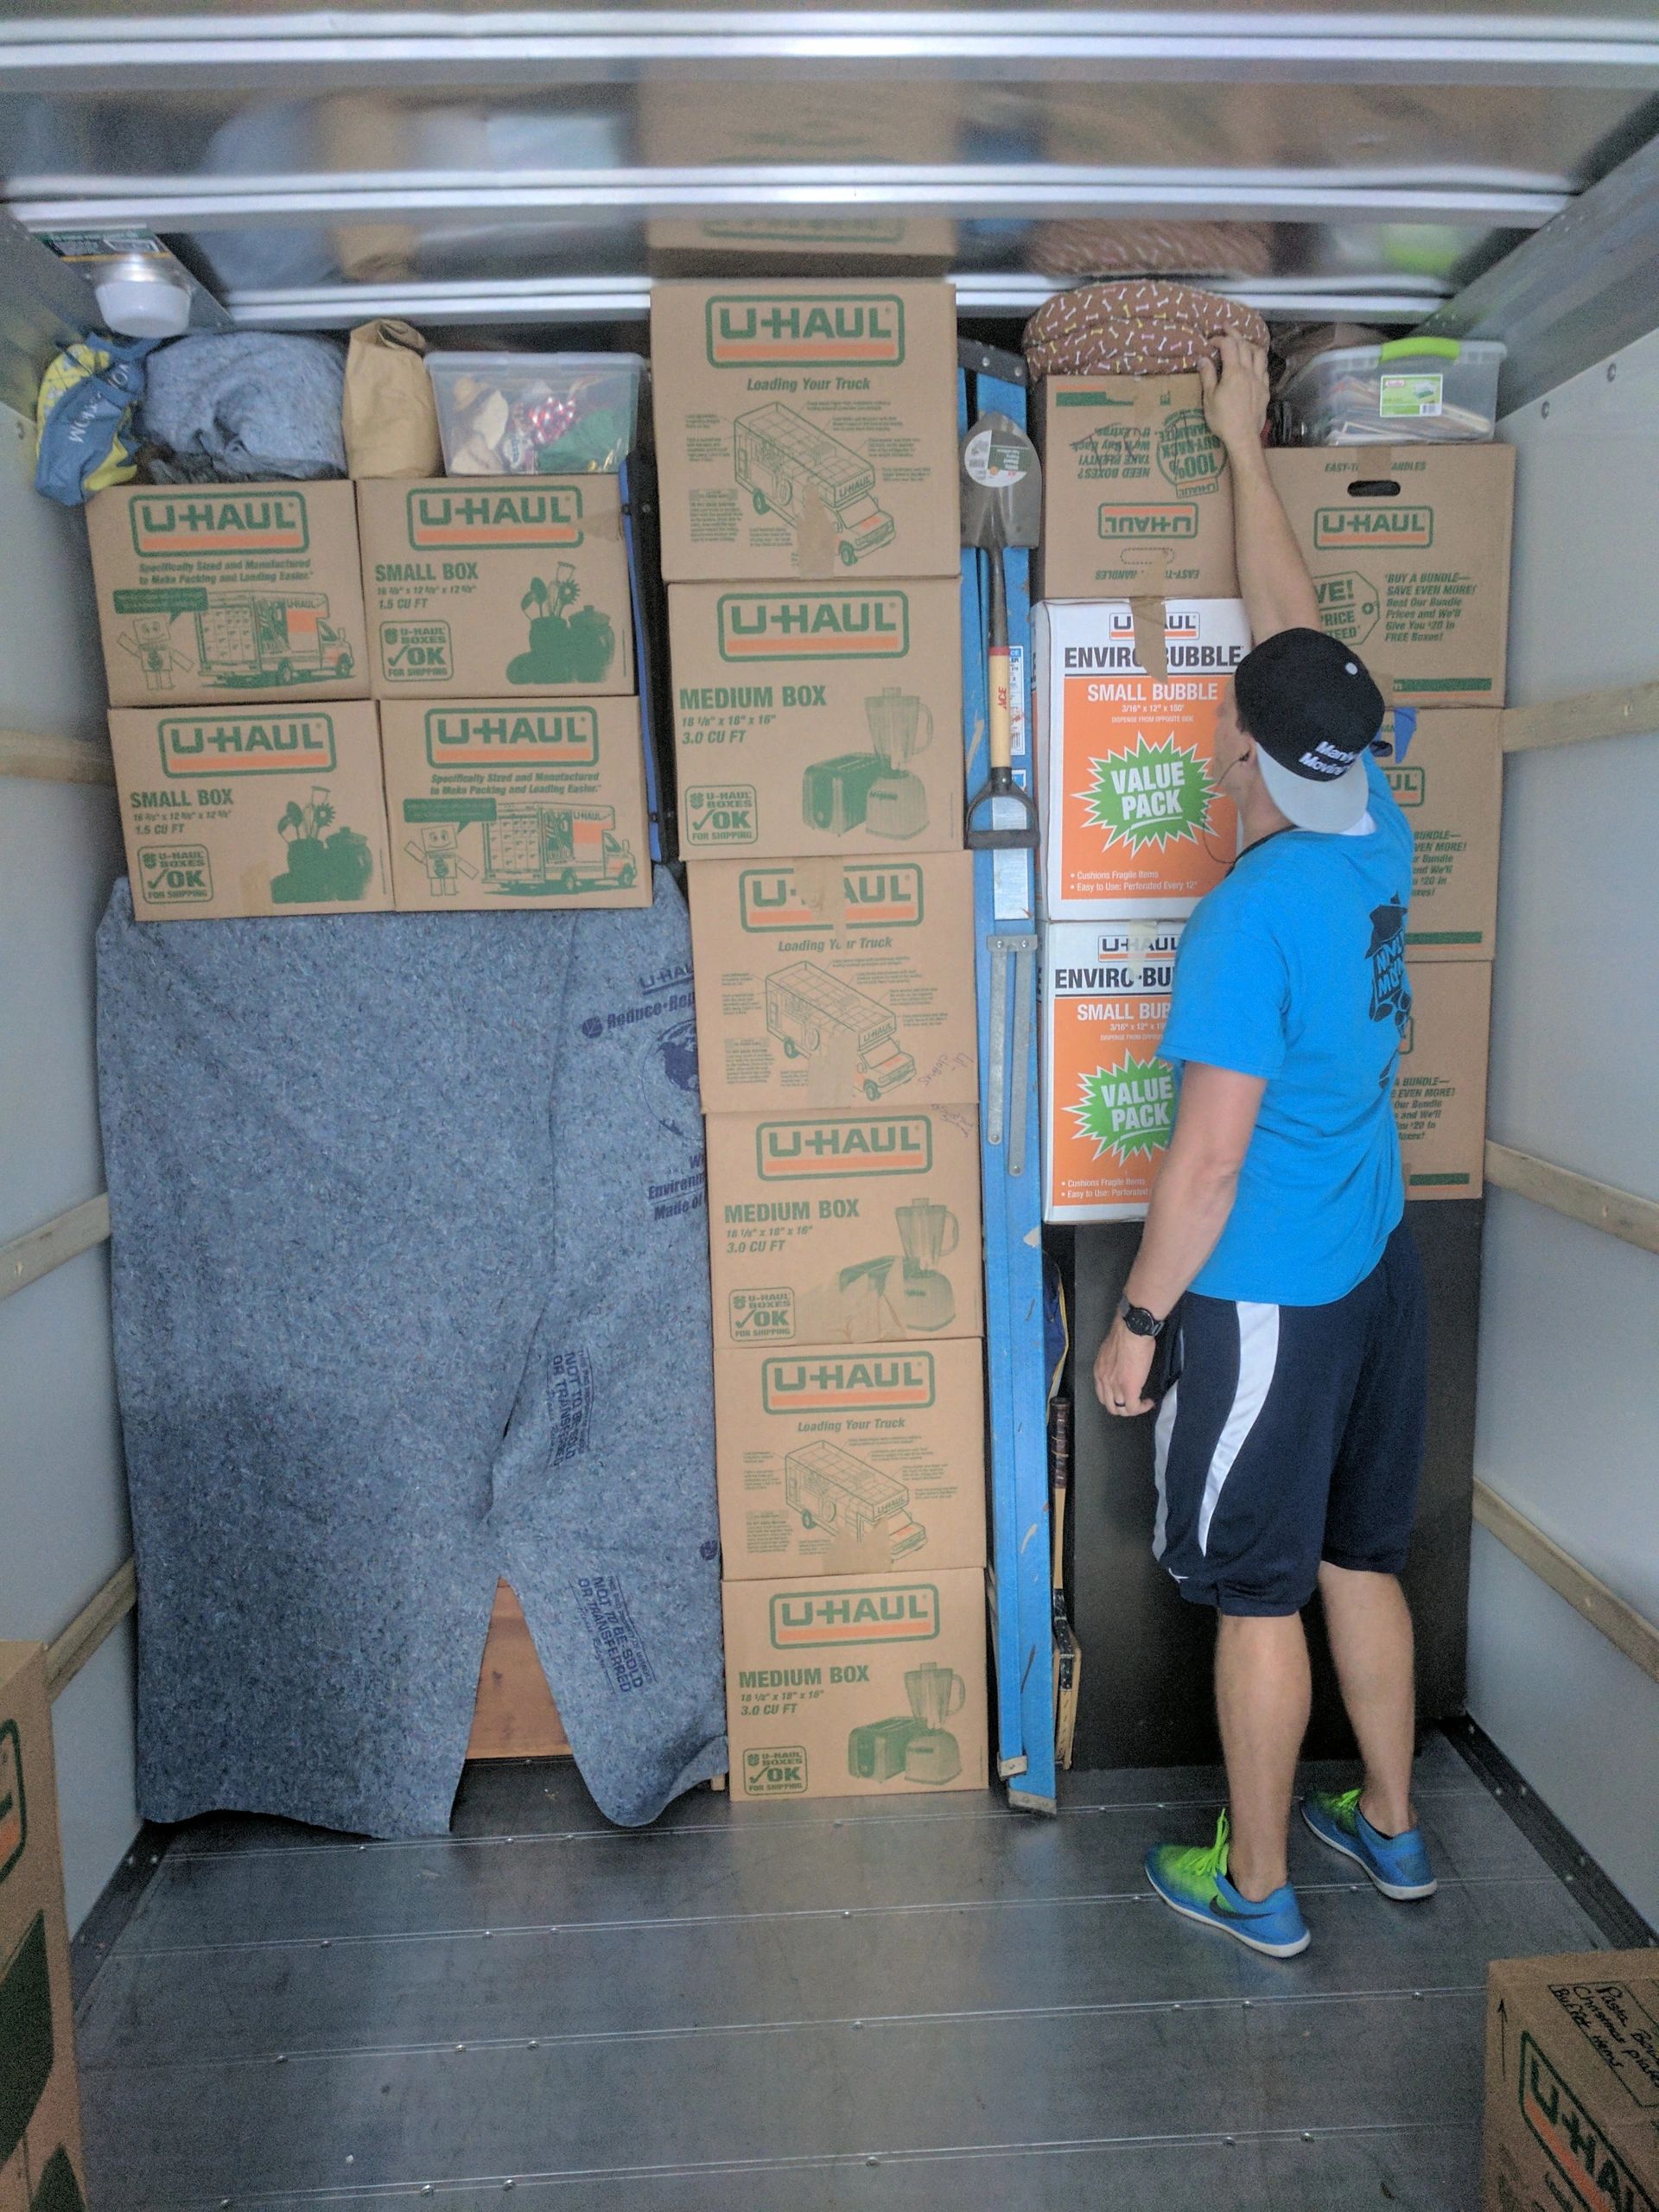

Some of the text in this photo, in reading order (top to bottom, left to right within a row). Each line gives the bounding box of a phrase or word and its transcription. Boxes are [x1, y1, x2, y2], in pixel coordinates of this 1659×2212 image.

[720, 307, 892, 340] U-HAUL
[747, 378, 871, 393] Loading Your Truck
[142, 501, 296, 531] U-HAUL
[419, 497, 571, 525] U-HAUL
[1105, 516, 1191, 533] U-HAUL
[1323, 513, 1425, 533] U-HAUL
[375, 563, 478, 582] SMALL BOX
[1409, 573, 1417, 583] A
[1387, 586, 1411, 595] SAVE
[1415, 585, 1440, 595] EVEN
[397, 598, 411, 608] CU
[415, 598, 428, 608] FT
[1410, 596, 1462, 607] Our Bundle
[731, 602, 896, 634] U-HAUL
[1386, 609, 1415, 620] Prices
[1385, 620, 1455, 631] Give You in
[1384, 632, 1408, 642] FREE
[408, 647, 446, 665] OK
[679, 685, 827, 709] MEDIUM BOX
[1088, 683, 1218, 702] SMALL BUBBLE
[171, 724, 323, 753] U-HAUL
[437, 716, 587, 745] U-HAUL
[682, 729, 747, 745] 3.0 CU FT
[515, 773, 531, 782] and
[1110, 761, 1185, 795] VALUE
[131, 788, 233, 808] SMALL BOX
[469, 785, 505, 796] Packing
[508, 785, 526, 794] and
[529, 785, 564, 795] Loading
[707, 799, 752, 808] BOXES
[1122, 789, 1183, 820] PACK
[155, 823, 185, 835] CU FT
[712, 810, 751, 830] OK
[692, 831, 752, 841] FOR SHIPPING
[167, 870, 206, 888] OK
[1077, 871, 1110, 880] Cushions
[1112, 871, 1137, 880] Fragile
[753, 875, 912, 907] U-AUL
[1077, 883, 1094, 892] Easy
[1105, 882, 1122, 891] Use:
[1164, 881, 1184, 891] Every
[778, 937, 893, 953] Loading Truck
[1077, 1004, 1134, 1020] SMALL
[1101, 1076, 1173, 1108] VALUE
[1111, 1102, 1171, 1132] PACK
[768, 1126, 920, 1157] U-HAUL
[653, 1202, 690, 1221] Made
[725, 1199, 860, 1223] MEDIUM BOX
[727, 1240, 785, 1254] 3.0 CU FT
[753, 1310, 789, 1327] OK
[553, 1354, 565, 1376] OR
[564, 1352, 581, 1385] NOT
[774, 1363, 924, 1392] U-HAUL
[798, 1417, 906, 1433] Loading Your Truck
[781, 1595, 929, 1626] U-HAUL
[578, 1579, 594, 1598] OR
[588, 1600, 632, 1693] TRANSFERRED
[592, 1577, 611, 1607] NOT
[622, 1649, 644, 1688] SOLD
[739, 1665, 869, 1688] MEDIUM BOX
[741, 1703, 798, 1716] 3.0 CU FT
[767, 1767, 801, 1782] OK
